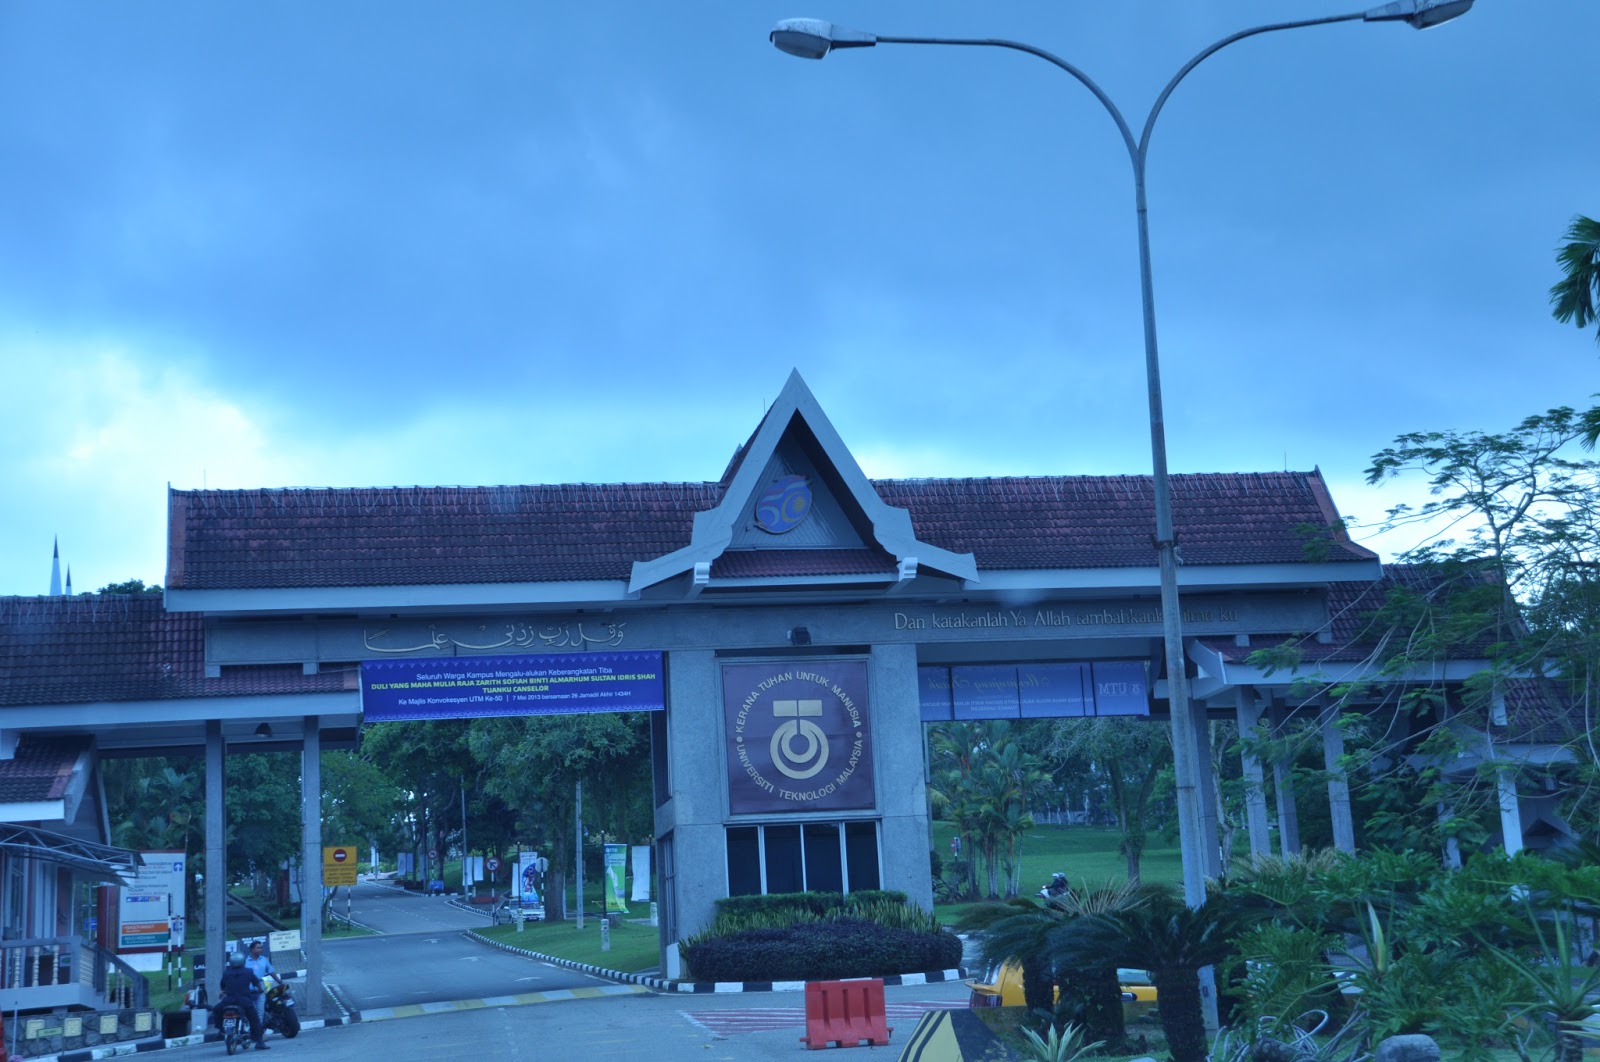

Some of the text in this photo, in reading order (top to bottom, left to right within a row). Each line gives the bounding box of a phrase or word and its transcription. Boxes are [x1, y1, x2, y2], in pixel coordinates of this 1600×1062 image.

[894, 605, 1238, 630] Dan katakanlah Ya Allah tambahkanla ilmu ku
[416, 666, 613, 682] Seluruh Warga Kampus Mengalu-alukan Keberangkatan Tiba
[512, 685, 549, 693] CANSELOR
[541, 692, 571, 700] bersamaan
[398, 698, 407, 706] Ke
[408, 697, 427, 706] Majlis
[427, 696, 468, 705] Konvokesyen
[735, 671, 862, 733] KERANA TUHAN UNTUK MANUSIA
[736, 739, 863, 801] UNIVERSITI TEKNOLOGI MALAYSIA
